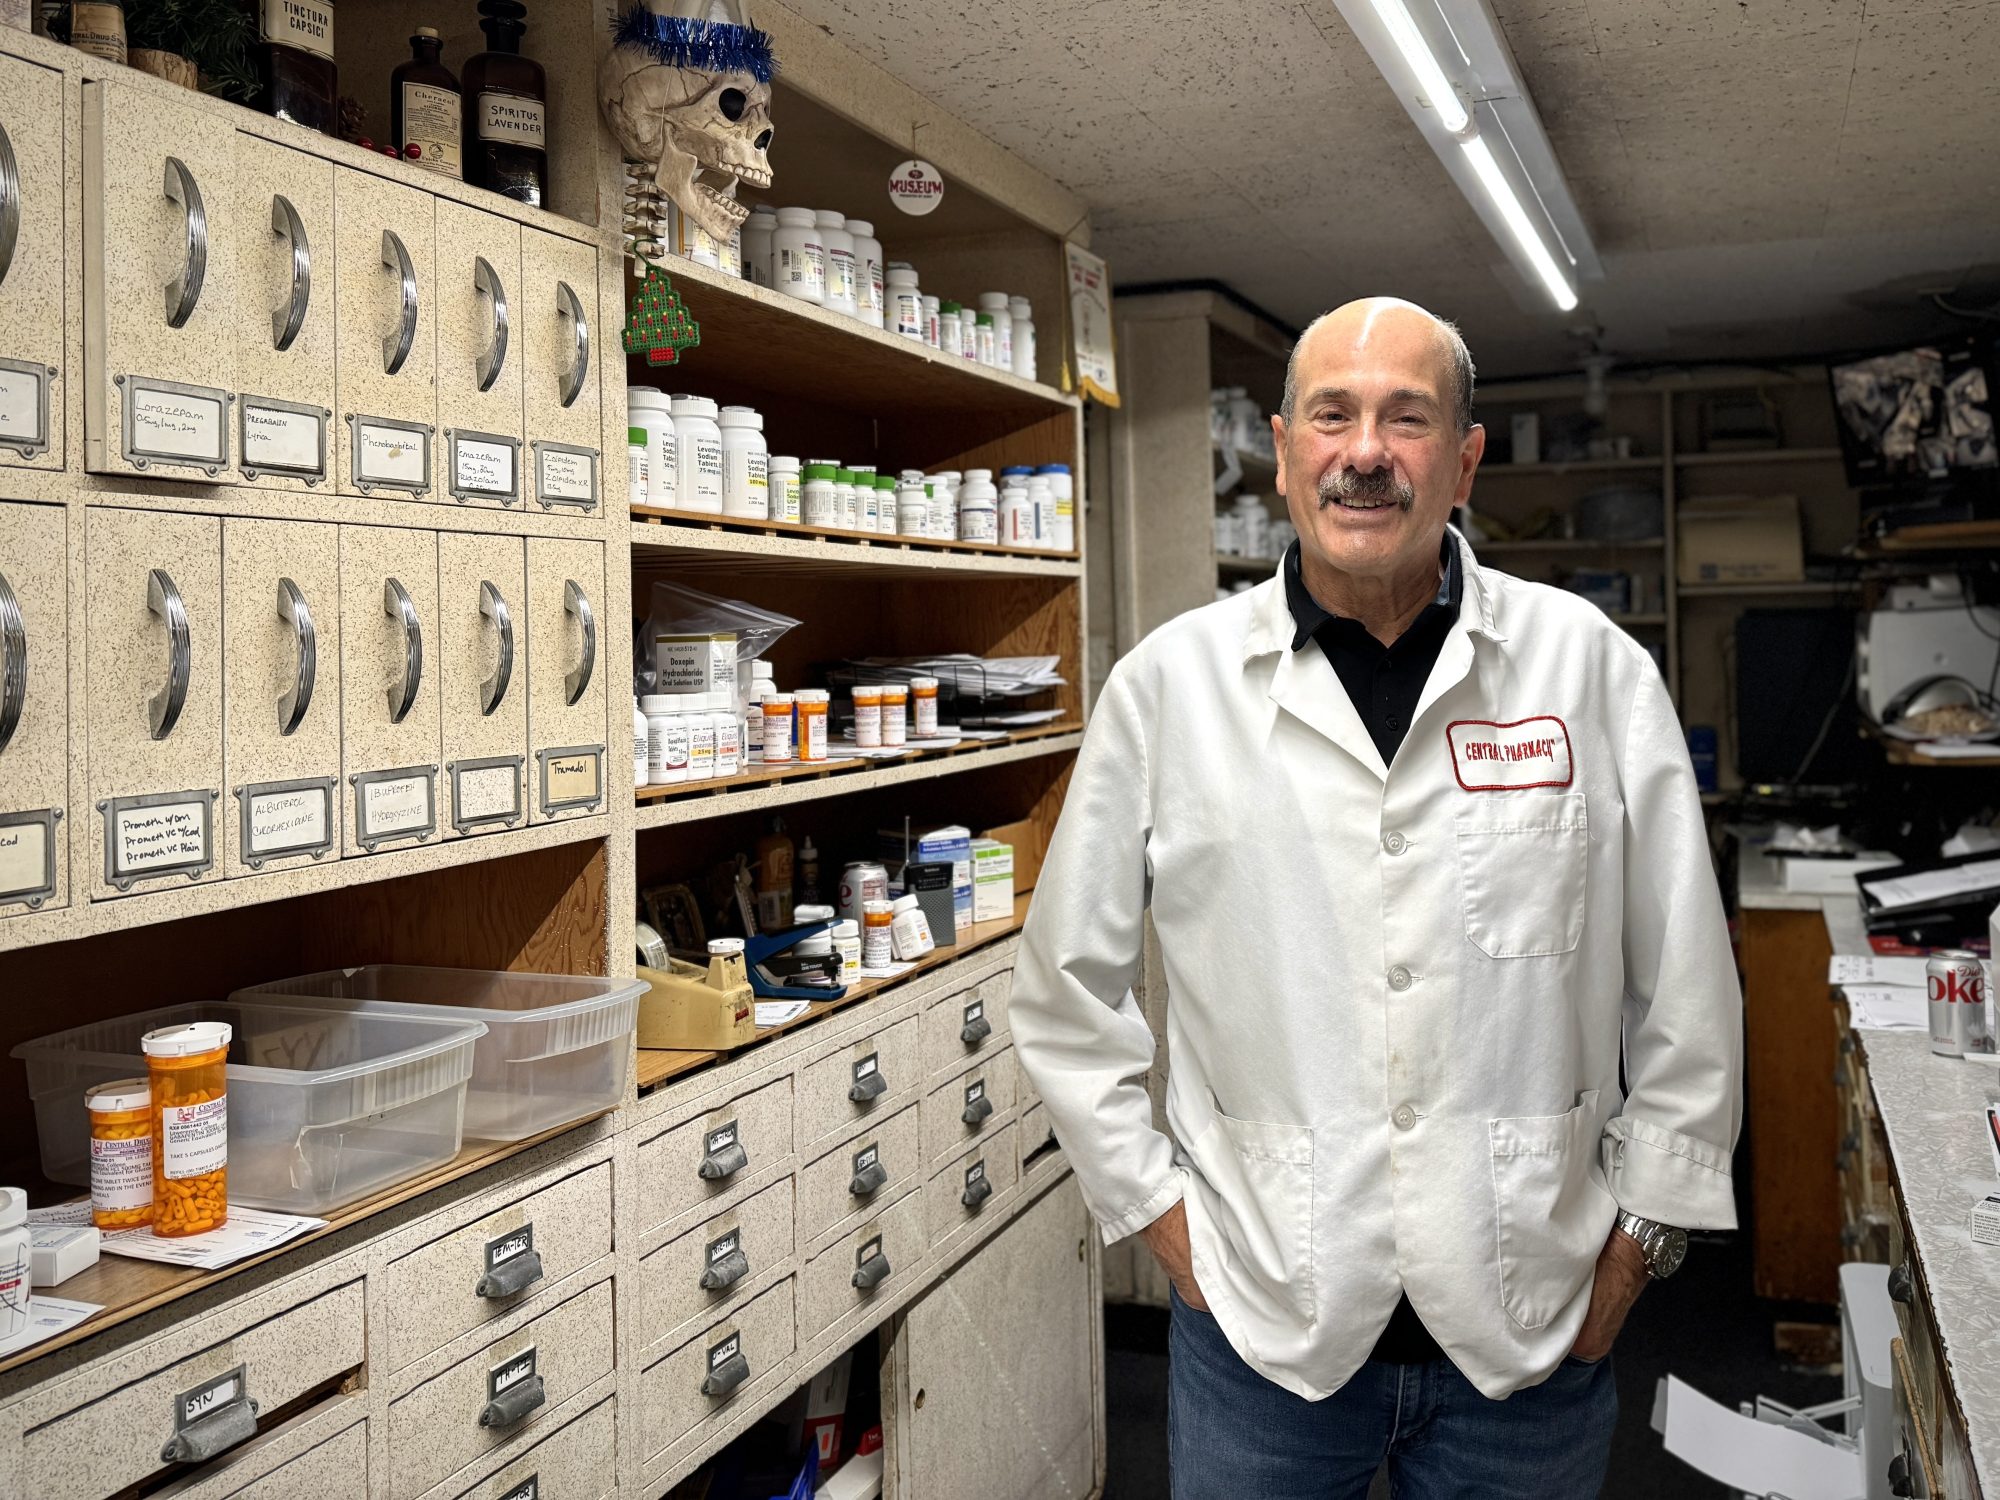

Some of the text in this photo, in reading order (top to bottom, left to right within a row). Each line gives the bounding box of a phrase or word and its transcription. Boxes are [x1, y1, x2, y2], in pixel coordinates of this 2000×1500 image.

[283, 1, 329, 27] TINCTURA
[290, 16, 324, 39] CAPSICI
[490, 105, 538, 121] SPIRITUS
[487, 118, 542, 136] LAVENDER
[889, 179, 942, 195] MUSEUM
[135, 394, 204, 421] Lorazepam
[246, 413, 288, 427] PREGABALIN
[247, 430, 272, 442] Lyrica
[458, 445, 501, 463] emazepam
[697, 452, 718, 461] Sodium
[670, 657, 695, 667] Doxepin
[662, 667, 704, 679] Hydrochloride
[1465, 742, 1505, 762] CENTRAL
[551, 760, 587, 775] Tramadol
[255, 796, 305, 817] ALBUTEROL
[123, 817, 163, 832] Prometh
[125, 832, 164, 849] Prometh
[165, 829, 177, 838] VC
[126, 841, 200, 865] Prometh VC Plain
[1927, 969, 1985, 1004] oke
[198, 1100, 221, 1112] CENTRAL
[105, 1141, 132, 1150] CENTRAL
[170, 1152, 183, 1160] TAKE
[189, 1146, 215, 1157] CAPSULES
[122, 1176, 140, 1184] TWICE
[187, 1389, 214, 1413] SYN
